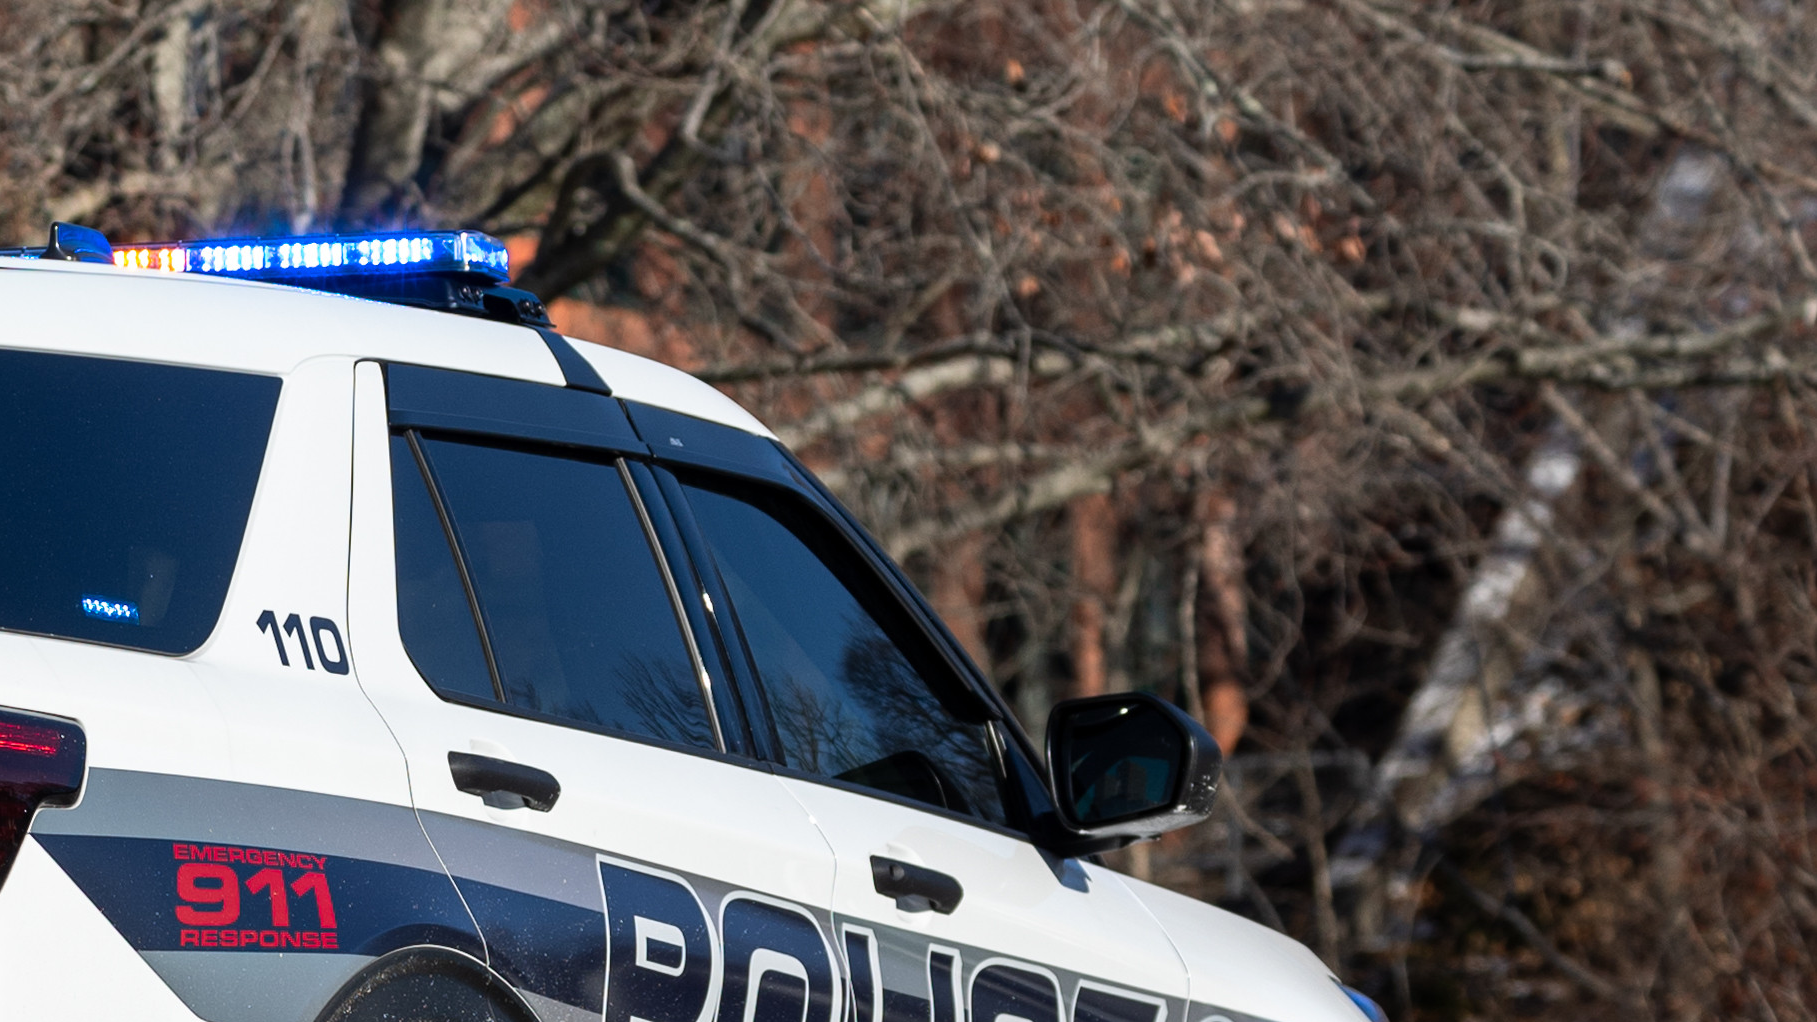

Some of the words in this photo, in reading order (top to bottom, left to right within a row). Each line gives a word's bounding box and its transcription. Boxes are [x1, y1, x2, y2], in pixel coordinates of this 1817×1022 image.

[256, 609, 349, 676] 110
[173, 843, 328, 871] EMERGENCY
[175, 863, 338, 930] 911
[180, 929, 339, 949] RESPONSE
